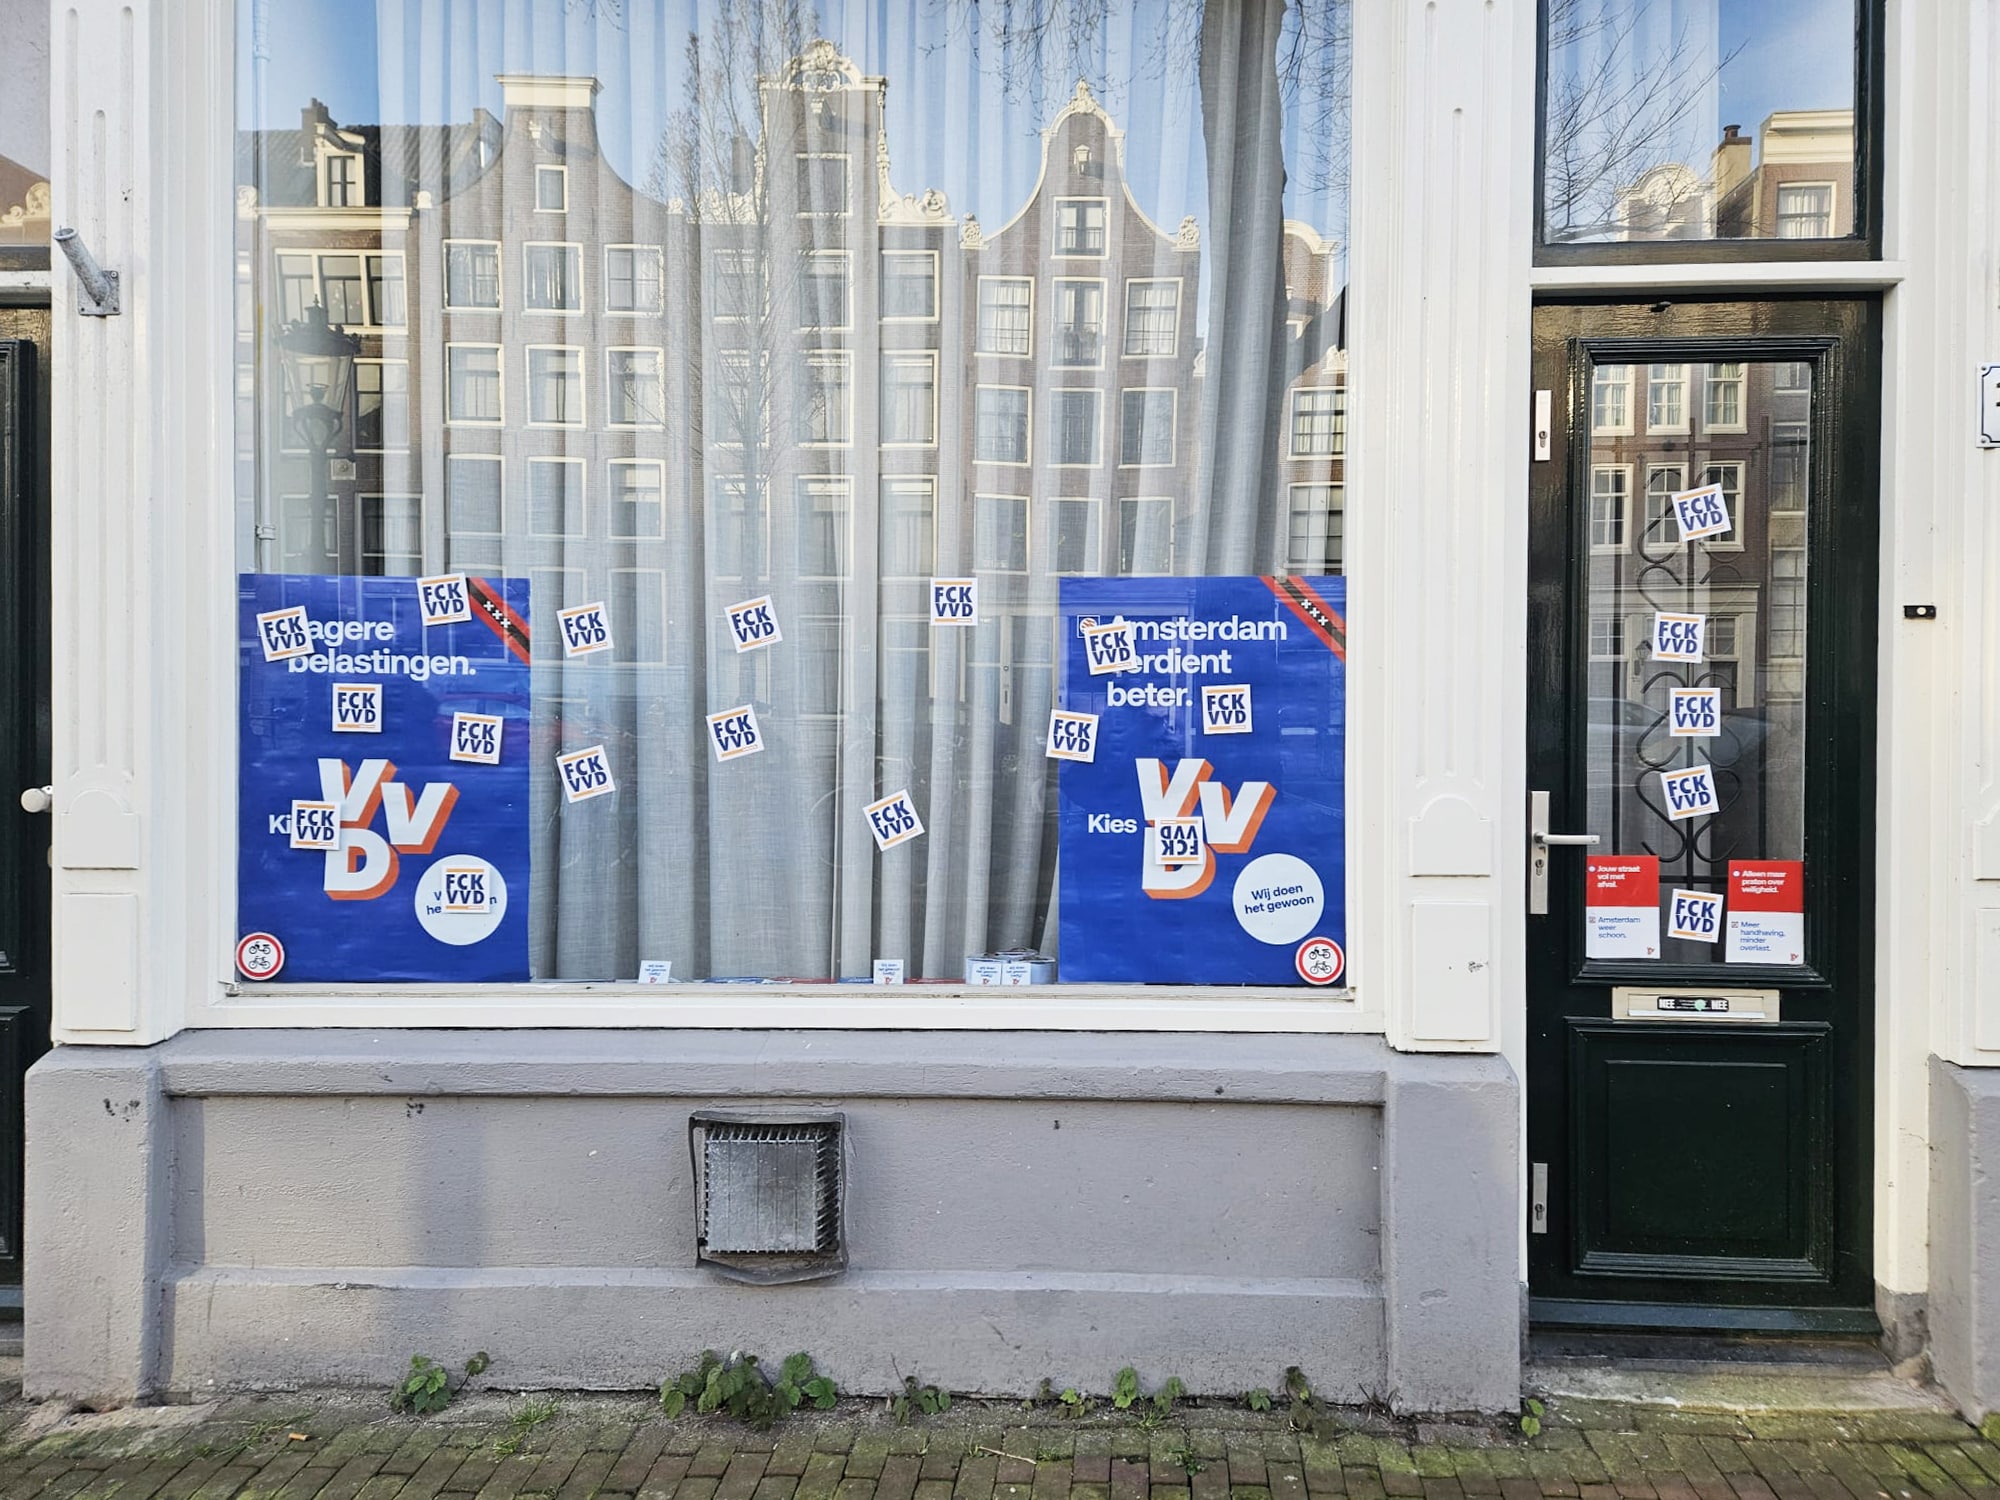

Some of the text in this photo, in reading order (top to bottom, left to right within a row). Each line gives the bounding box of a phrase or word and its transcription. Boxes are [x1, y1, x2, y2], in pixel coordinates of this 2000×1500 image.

[1679, 494, 1719, 518] FCK
[1683, 511, 1722, 530] VVD
[423, 583, 462, 602] FCK
[935, 587, 972, 602] FCK
[425, 599, 464, 616] VVD
[936, 602, 973, 616] VVD
[264, 616, 303, 638] FCK
[564, 612, 603, 634] FCK
[732, 606, 771, 630] FCK
[308, 620, 394, 647] agere
[568, 628, 606, 647] VVD
[736, 622, 774, 642] VVD
[1659, 621, 1698, 639] FCK
[267, 633, 306, 651] VVD
[1090, 631, 1128, 651] FCK
[1659, 638, 1697, 653] VVD
[288, 648, 477, 681] belastingen.
[1093, 648, 1130, 665] VVD
[1126, 648, 1232, 674] erdient
[338, 692, 375, 709] FCK
[1107, 682, 1193, 707] beter.
[1207, 694, 1244, 711] FCK
[1675, 697, 1714, 713] FCK
[338, 708, 376, 723] VVD
[1208, 710, 1246, 724] VVD
[1675, 713, 1714, 727] VVD
[457, 722, 495, 740] FCK
[713, 715, 752, 738] FCK
[1054, 719, 1091, 739] FCK
[457, 737, 494, 754] VVD
[718, 731, 755, 751] VVD
[1053, 735, 1089, 752] VVD
[564, 755, 603, 780] FCK
[569, 772, 607, 792] VVD
[1667, 775, 1708, 797] FCK
[1671, 791, 1710, 810] VVD
[296, 809, 334, 826] FCK
[871, 800, 910, 829] FCK
[1088, 814, 1137, 833] Kies
[297, 825, 334, 840] VVD
[317, 758, 460, 900] VVD
[877, 816, 914, 839] VVD
[1160, 826, 1198, 839] VVD
[1161, 839, 1198, 855] FCK
[446, 874, 484, 890] FCK
[446, 889, 484, 904] VVD
[1251, 883, 1303, 901] Wij doen
[426, 905, 442, 915] he
[1244, 894, 1315, 914] het gewoon
[1676, 899, 1715, 919] FCK
[1676, 915, 1714, 932] VVD
